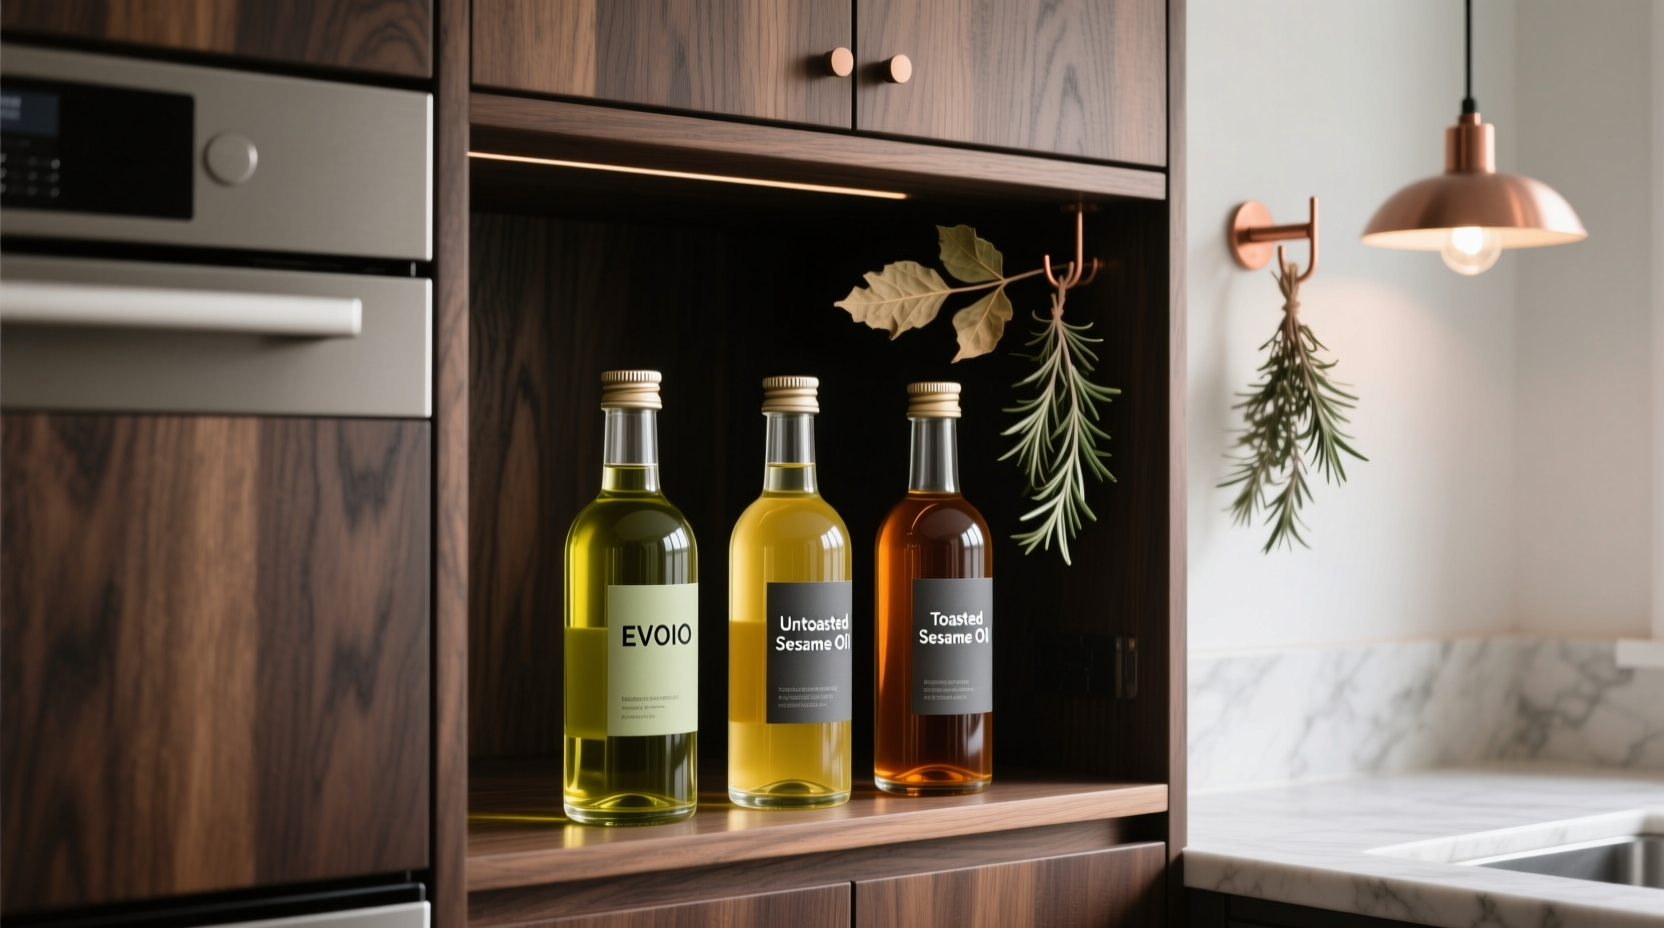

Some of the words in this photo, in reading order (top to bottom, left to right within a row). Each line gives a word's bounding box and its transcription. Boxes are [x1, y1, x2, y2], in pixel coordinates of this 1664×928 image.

[780, 613, 849, 632] Untoasted
[930, 610, 983, 627] Toasted
[622, 623, 692, 647] EVOIO
[775, 635, 833, 652] Sesame
[919, 628, 973, 645] Sesame
